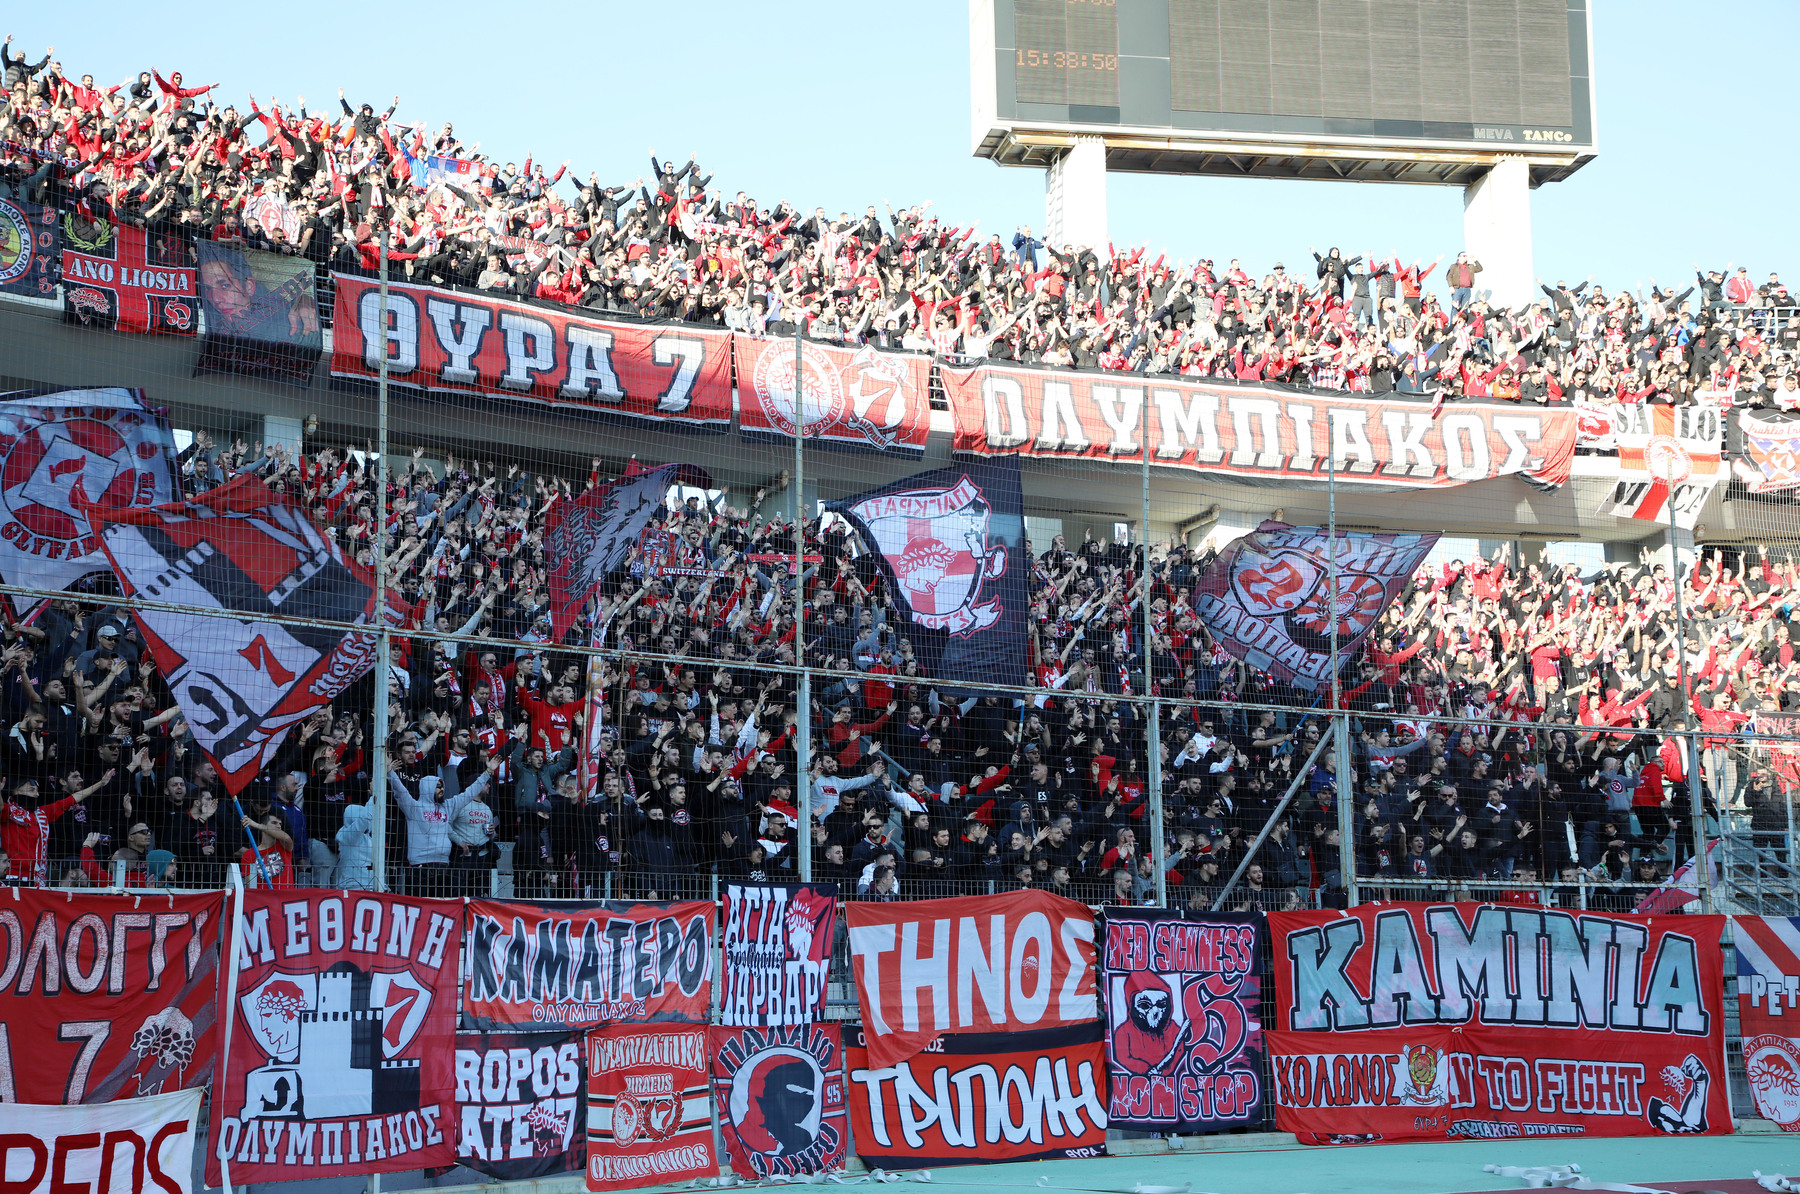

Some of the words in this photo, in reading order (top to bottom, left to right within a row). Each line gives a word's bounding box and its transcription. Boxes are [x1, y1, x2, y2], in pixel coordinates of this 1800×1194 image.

[1016, 49, 1118, 71] 15:38:50
[1474, 128, 1513, 140] MEVA
[0, 204, 30, 236] MOKE
[13, 239, 31, 276] ALONE
[36, 206, 56, 294] BOYS
[69, 257, 114, 282] ANO
[120, 266, 189, 292] LIOSIA
[358, 288, 626, 404] ΘΥΡΑ
[652, 333, 705, 413] 7
[780, 416, 832, 436] ΦΙΛΘΛΩΝ
[981, 373, 1544, 482] ΟΛΥΜΠΙΑΚΟΣ
[662, 566, 726, 578] SWITZERLAND
[468, 810, 490, 819] CRAZY
[231, 896, 456, 972] ΜΕΘΩΝΗ
[470, 913, 709, 1004] ΚΑΜΑΤΕΡΟ
[1106, 920, 1151, 972] RED
[1154, 923, 1254, 973] SICKNESS
[849, 911, 1098, 1037] ΤΗΝΟΣ
[1744, 1036, 1800, 1059] ΟΛΥΜΠΙΑΚΟΣ
[826, 1083, 842, 1104] 95
[850, 1056, 1108, 1149] ΤΡΙΠΟΛΗ
[1109, 1073, 1178, 1121] NON
[1180, 1072, 1258, 1121] STOP
[1275, 1055, 1400, 1107] ΚΟΛΩΝΟΣ
[1477, 1053, 1532, 1112] TO
[1534, 1057, 1646, 1116] FIGHT
[216, 1104, 444, 1167] ΟΛΥΜΠΙΑΚΟΣ
[455, 1103, 535, 1162] ATE
[590, 1143, 710, 1181] OLYMPIAKOS
